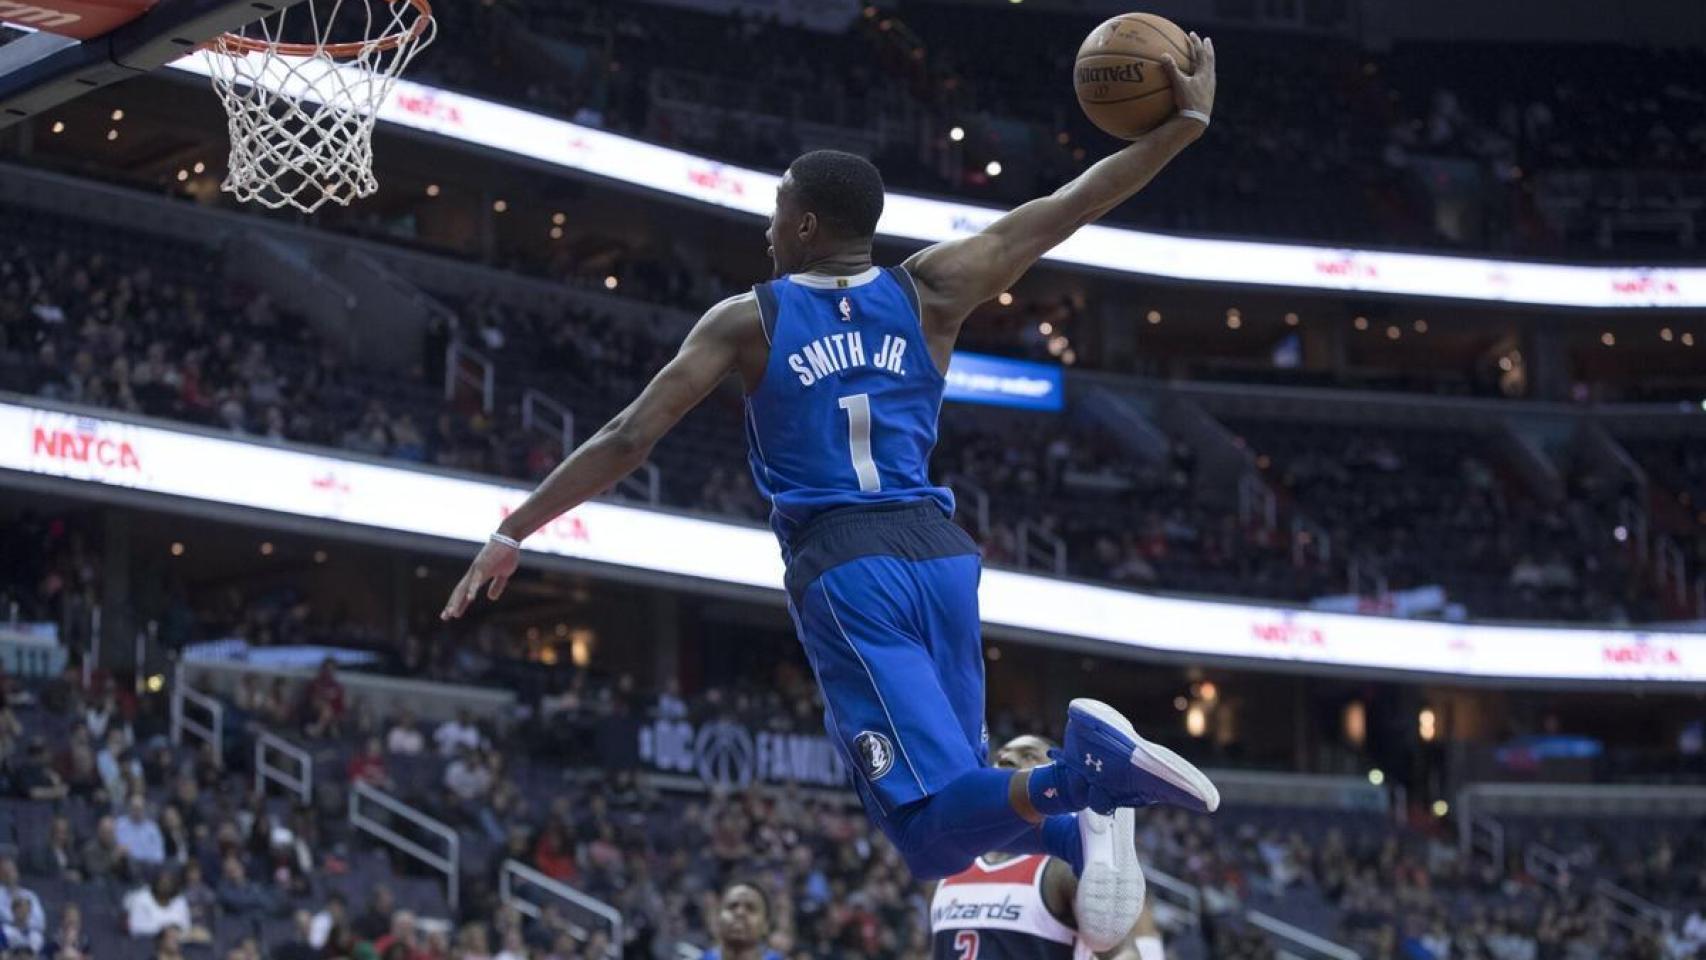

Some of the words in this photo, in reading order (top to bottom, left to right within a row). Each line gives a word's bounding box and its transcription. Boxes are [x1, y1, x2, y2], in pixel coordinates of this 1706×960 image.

[1078, 61, 1144, 84] SPALDIN
[788, 331, 867, 387] SMITH
[873, 334, 907, 376] JR.
[33, 426, 141, 472] NATCA
[838, 392, 881, 493] 1
